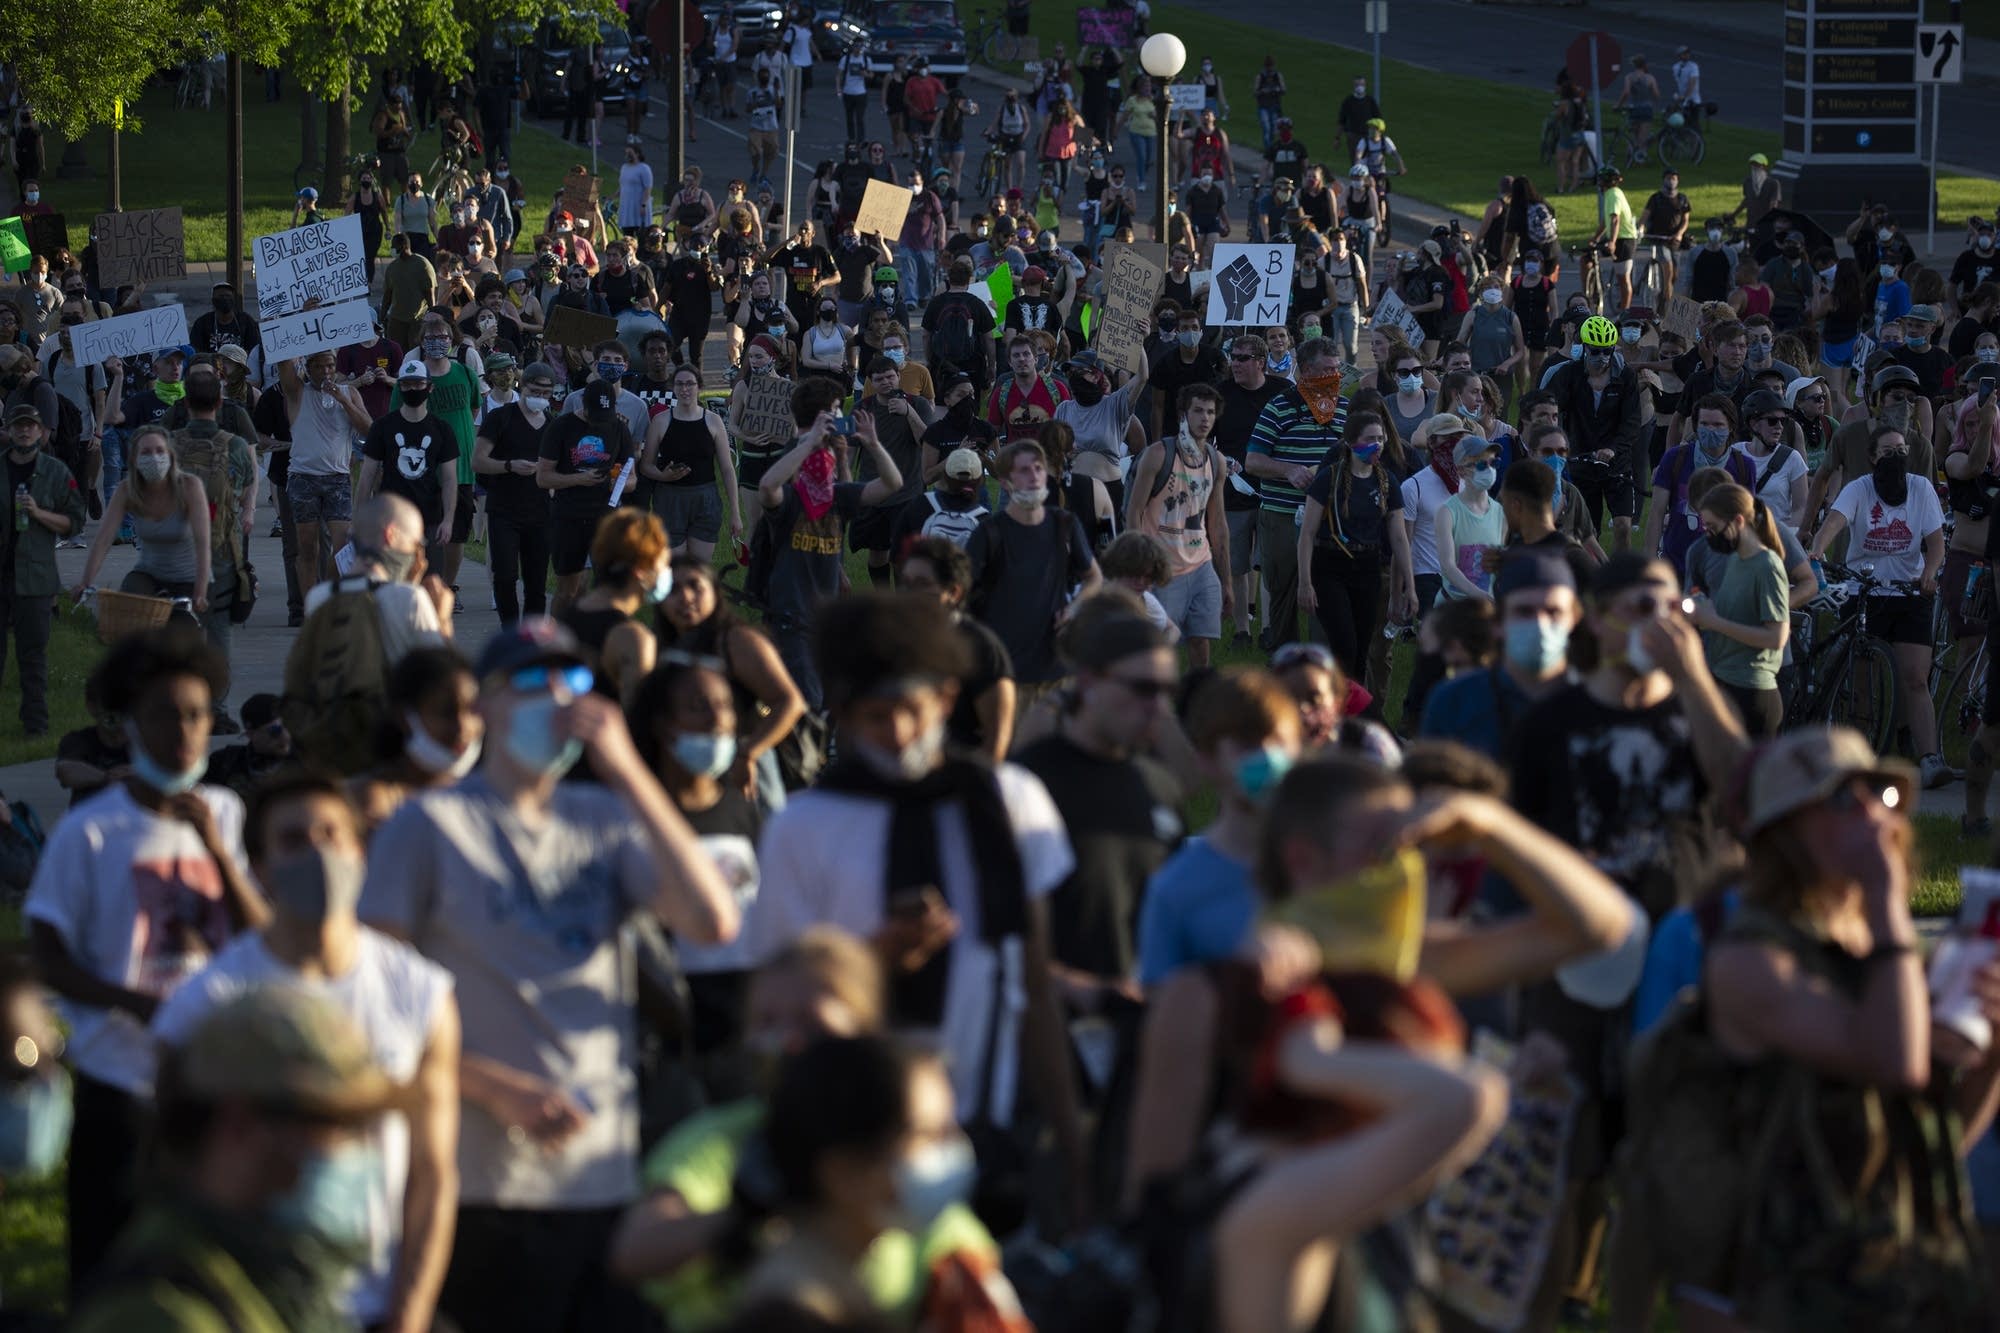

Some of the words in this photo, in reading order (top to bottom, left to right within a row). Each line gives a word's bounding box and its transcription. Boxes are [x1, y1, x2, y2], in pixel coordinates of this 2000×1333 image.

[97, 211, 165, 241] BLACK
[115, 237, 175, 258] LIVES
[260, 223, 334, 268] BLACK
[128, 256, 187, 281] MATTER
[1119, 258, 1152, 286] STOP
[259, 291, 287, 309] FUCKING
[1110, 285, 1125, 300] YOUR
[1125, 291, 1151, 311] RACISM
[1124, 303, 1132, 314] IS
[144, 307, 181, 347] 12
[303, 318, 322, 341] 4
[321, 312, 368, 339] George
[1105, 304, 1141, 331] PATRIOTIS
[750, 376, 795, 398] BLACK
[746, 395, 792, 416] LIVES
